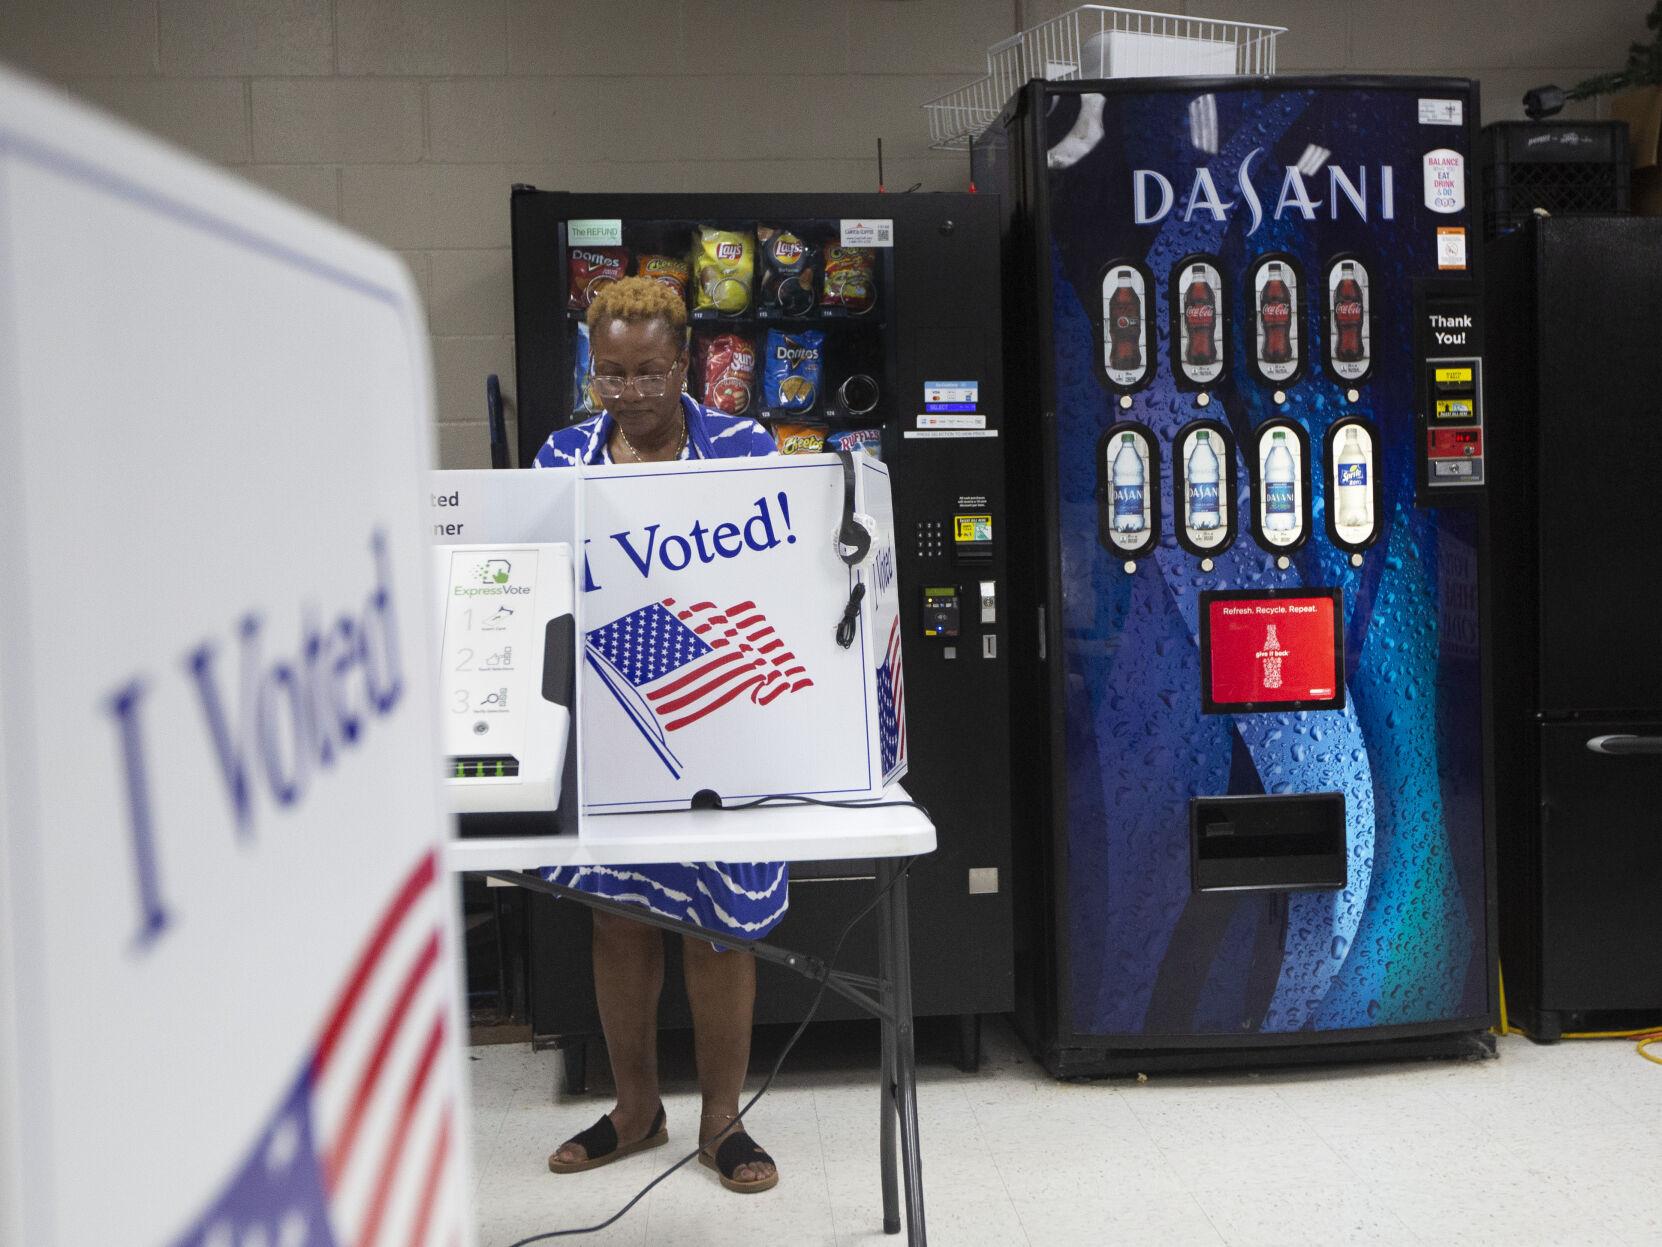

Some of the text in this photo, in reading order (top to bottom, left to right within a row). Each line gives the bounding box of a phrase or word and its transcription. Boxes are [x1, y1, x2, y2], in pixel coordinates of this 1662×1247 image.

[1428, 158, 1459, 166] BALANCE
[1434, 180, 1455, 188] DRINK
[1437, 172, 1450, 180] EAT
[1133, 147, 1394, 237] DASANI
[572, 227, 619, 237] The REFUND
[572, 249, 620, 268] Doritos
[718, 241, 742, 260] Lay's
[1429, 314, 1473, 328] Thank
[1435, 332, 1467, 345] You!
[777, 346, 819, 361] Doritos
[784, 434, 824, 455] Cheetos
[840, 429, 881, 450] RUFFLES
[610, 491, 798, 579] Voted!
[454, 584, 531, 598] ExpressVote
[1223, 604, 1318, 616] Refresh. Recycle. Repeat.
[463, 607, 473, 632] 1
[455, 647, 474, 672] 2
[1255, 651, 1268, 659] give
[451, 688, 470, 715] 3
[102, 520, 405, 960] I Voted
